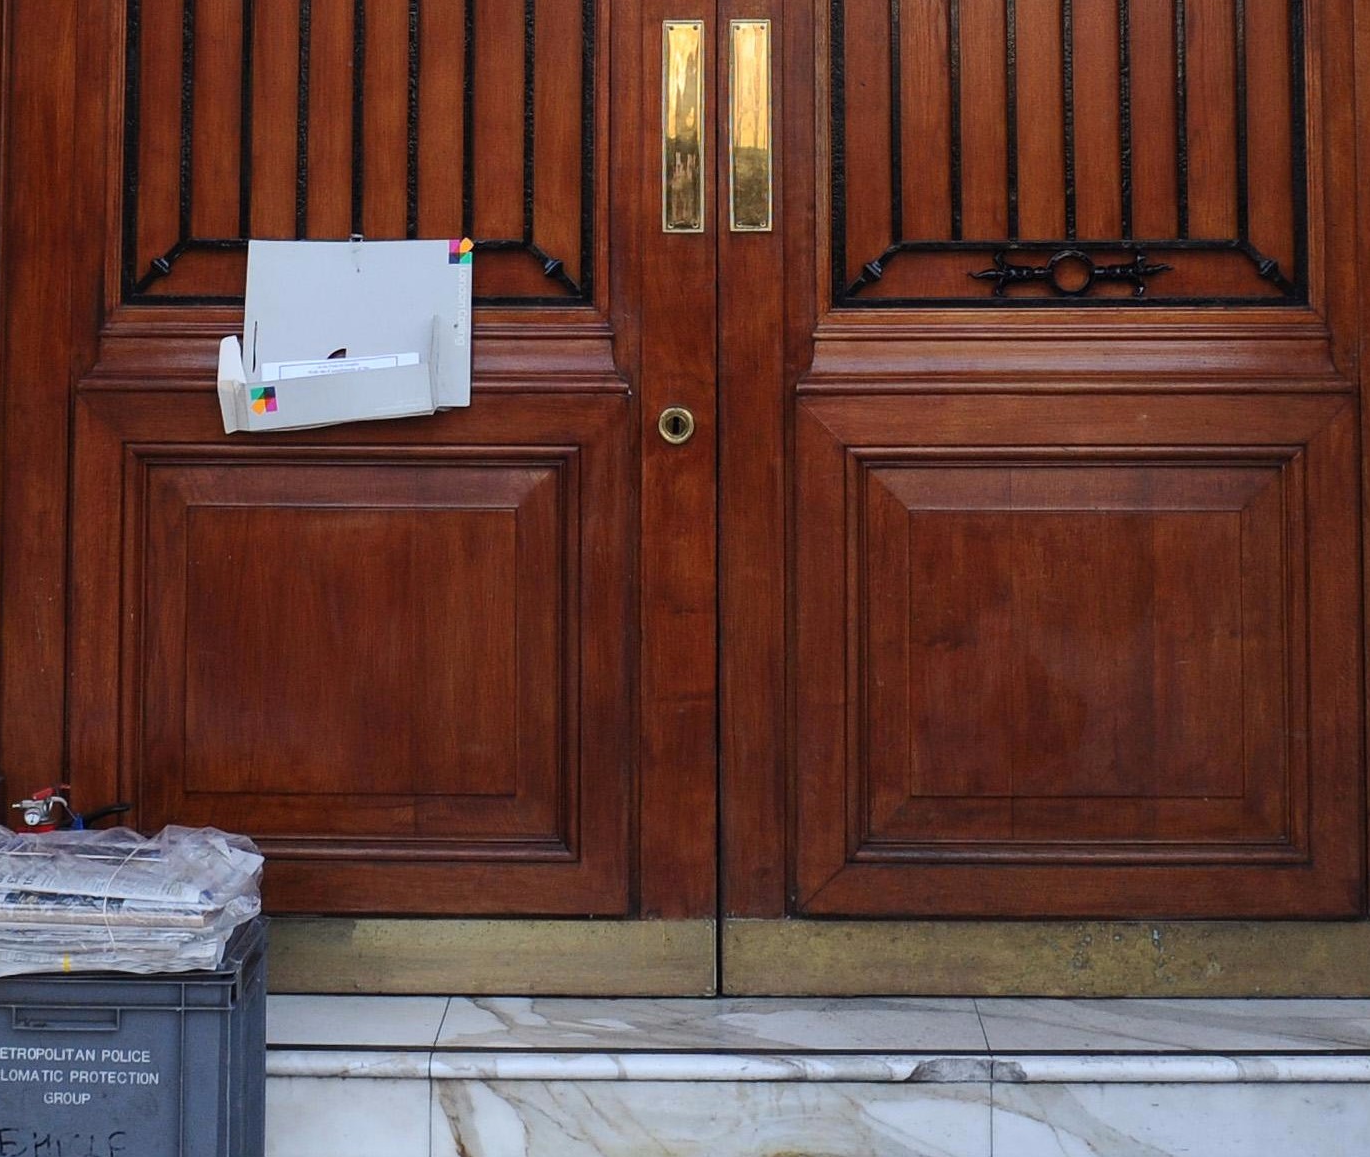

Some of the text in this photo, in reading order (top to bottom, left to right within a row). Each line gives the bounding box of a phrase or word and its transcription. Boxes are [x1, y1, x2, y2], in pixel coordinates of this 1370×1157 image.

[101, 1049, 151, 1063] POLICE
[69, 1070, 159, 1084] PROTECTION
[43, 1092, 91, 1105] GROUP
